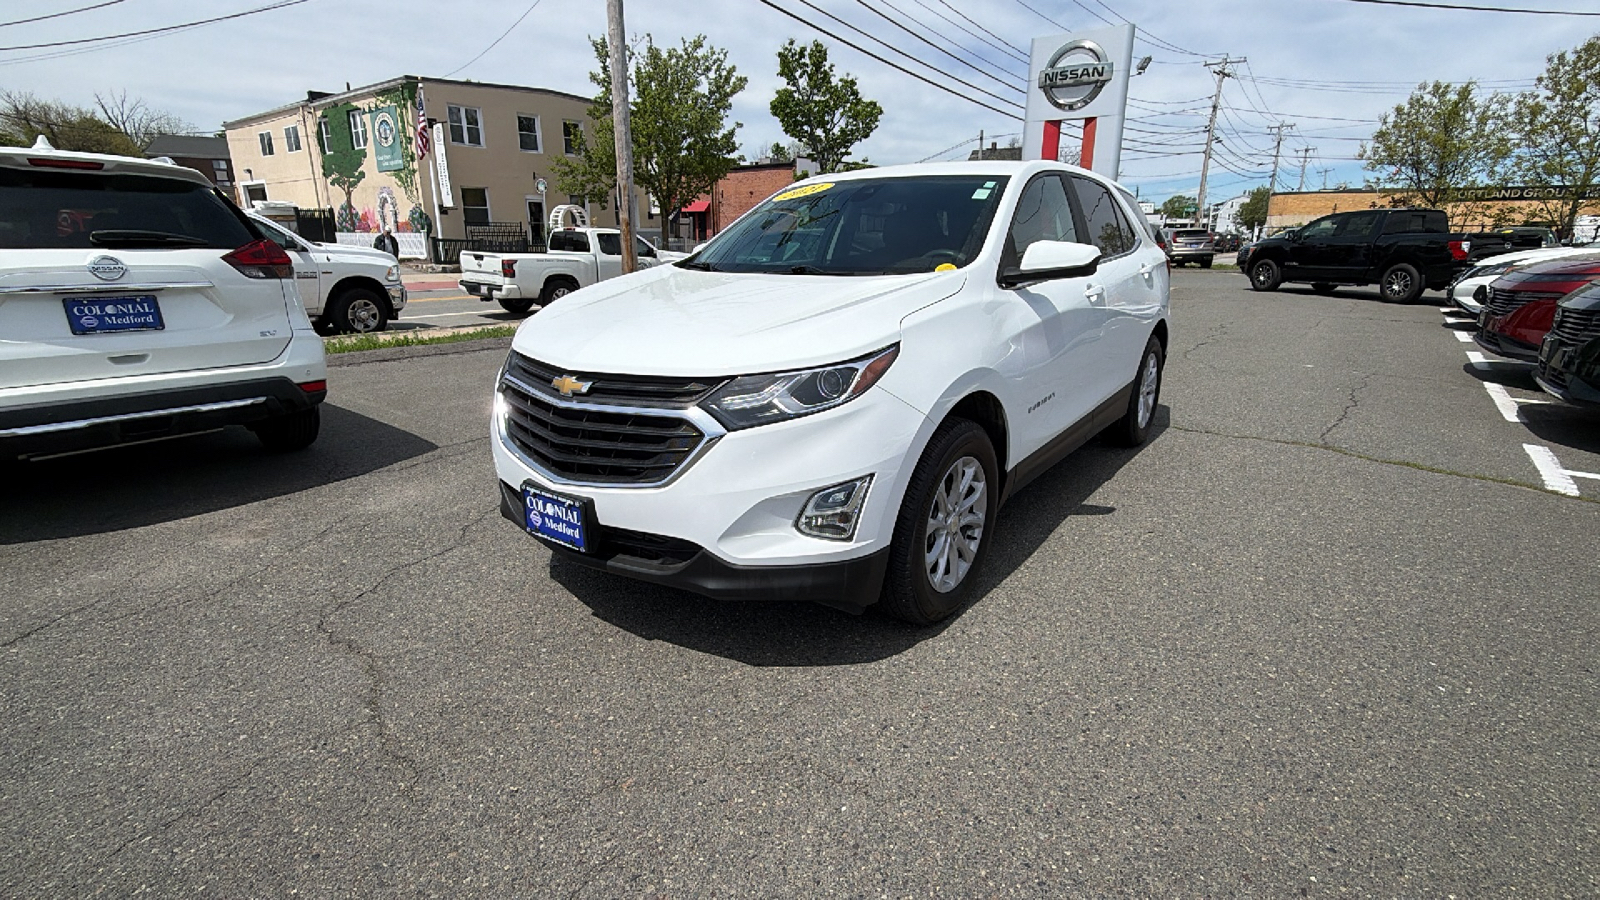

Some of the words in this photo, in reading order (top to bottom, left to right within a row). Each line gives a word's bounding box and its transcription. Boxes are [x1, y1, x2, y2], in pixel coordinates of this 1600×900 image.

[1044, 66, 1105, 83] NISSAN
[1453, 188, 1521, 199] ORTLAND
[73, 303, 154, 316] COLONIAL
[104, 315, 154, 325] Medford
[526, 495, 581, 526] COLONIAL
[544, 517, 580, 539] Medford
